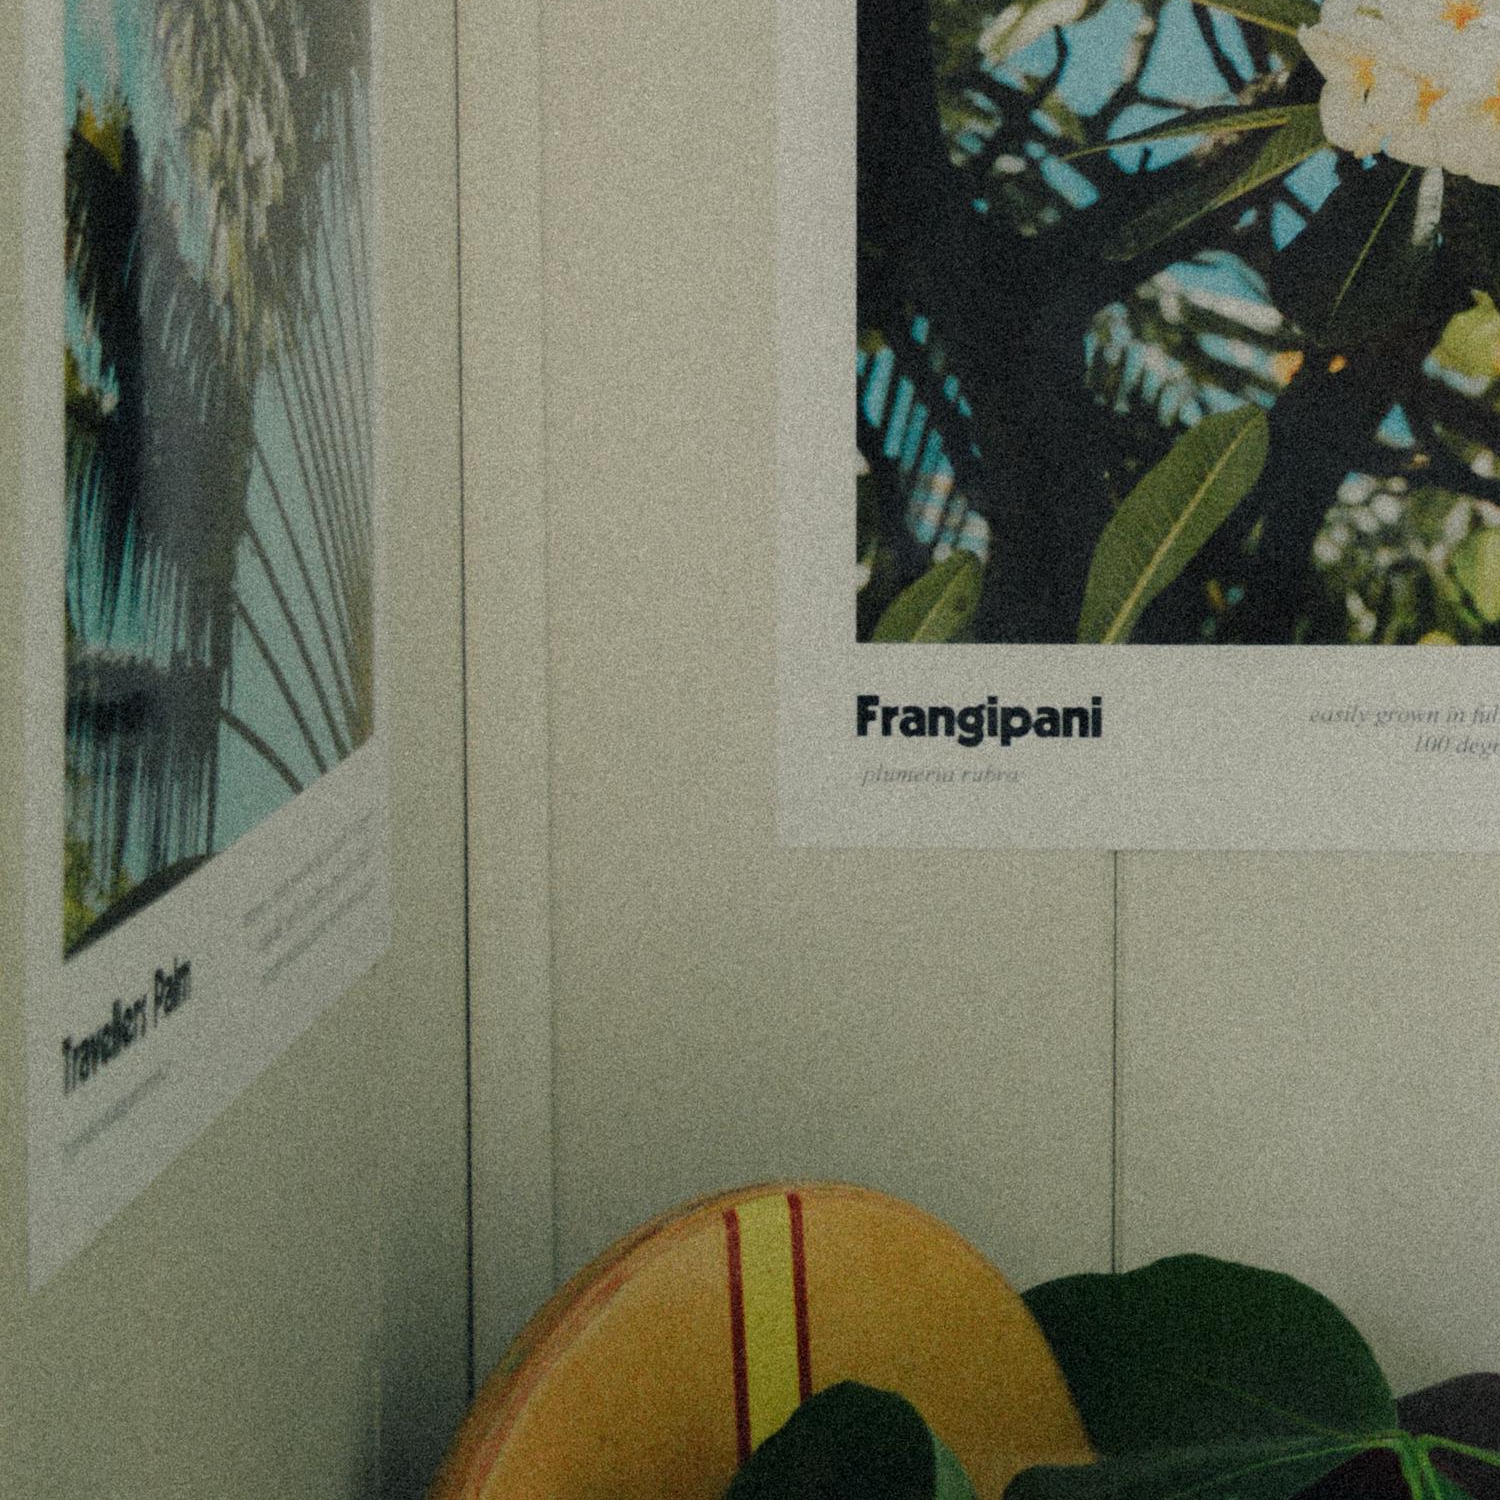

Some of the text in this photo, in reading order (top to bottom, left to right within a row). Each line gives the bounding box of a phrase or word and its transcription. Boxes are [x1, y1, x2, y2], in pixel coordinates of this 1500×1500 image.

[856, 694, 1103, 748] Frangipani
[1309, 704, 1367, 728] easily
[1373, 709, 1440, 728] grown
[1446, 706, 1465, 724] in
[1414, 735, 1450, 755] 100
